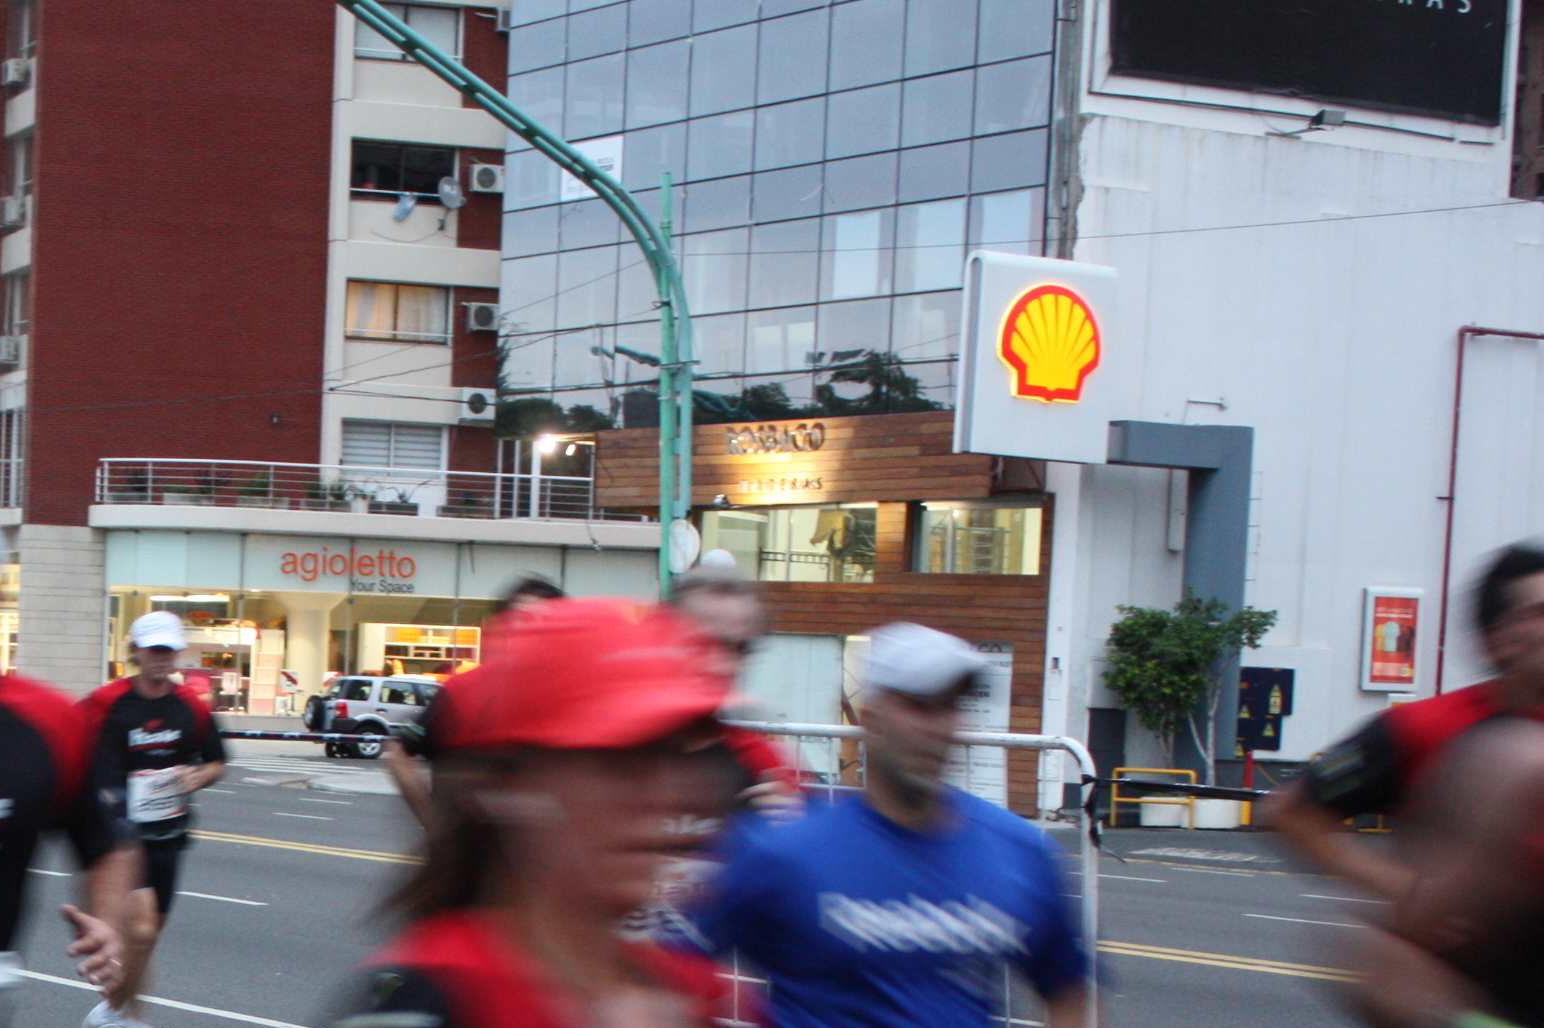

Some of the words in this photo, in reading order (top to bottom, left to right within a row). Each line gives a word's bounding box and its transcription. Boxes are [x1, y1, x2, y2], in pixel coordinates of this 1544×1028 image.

[280, 546, 416, 582] agioletto
[351, 578, 375, 593] Your
[379, 579, 415, 595] Space
